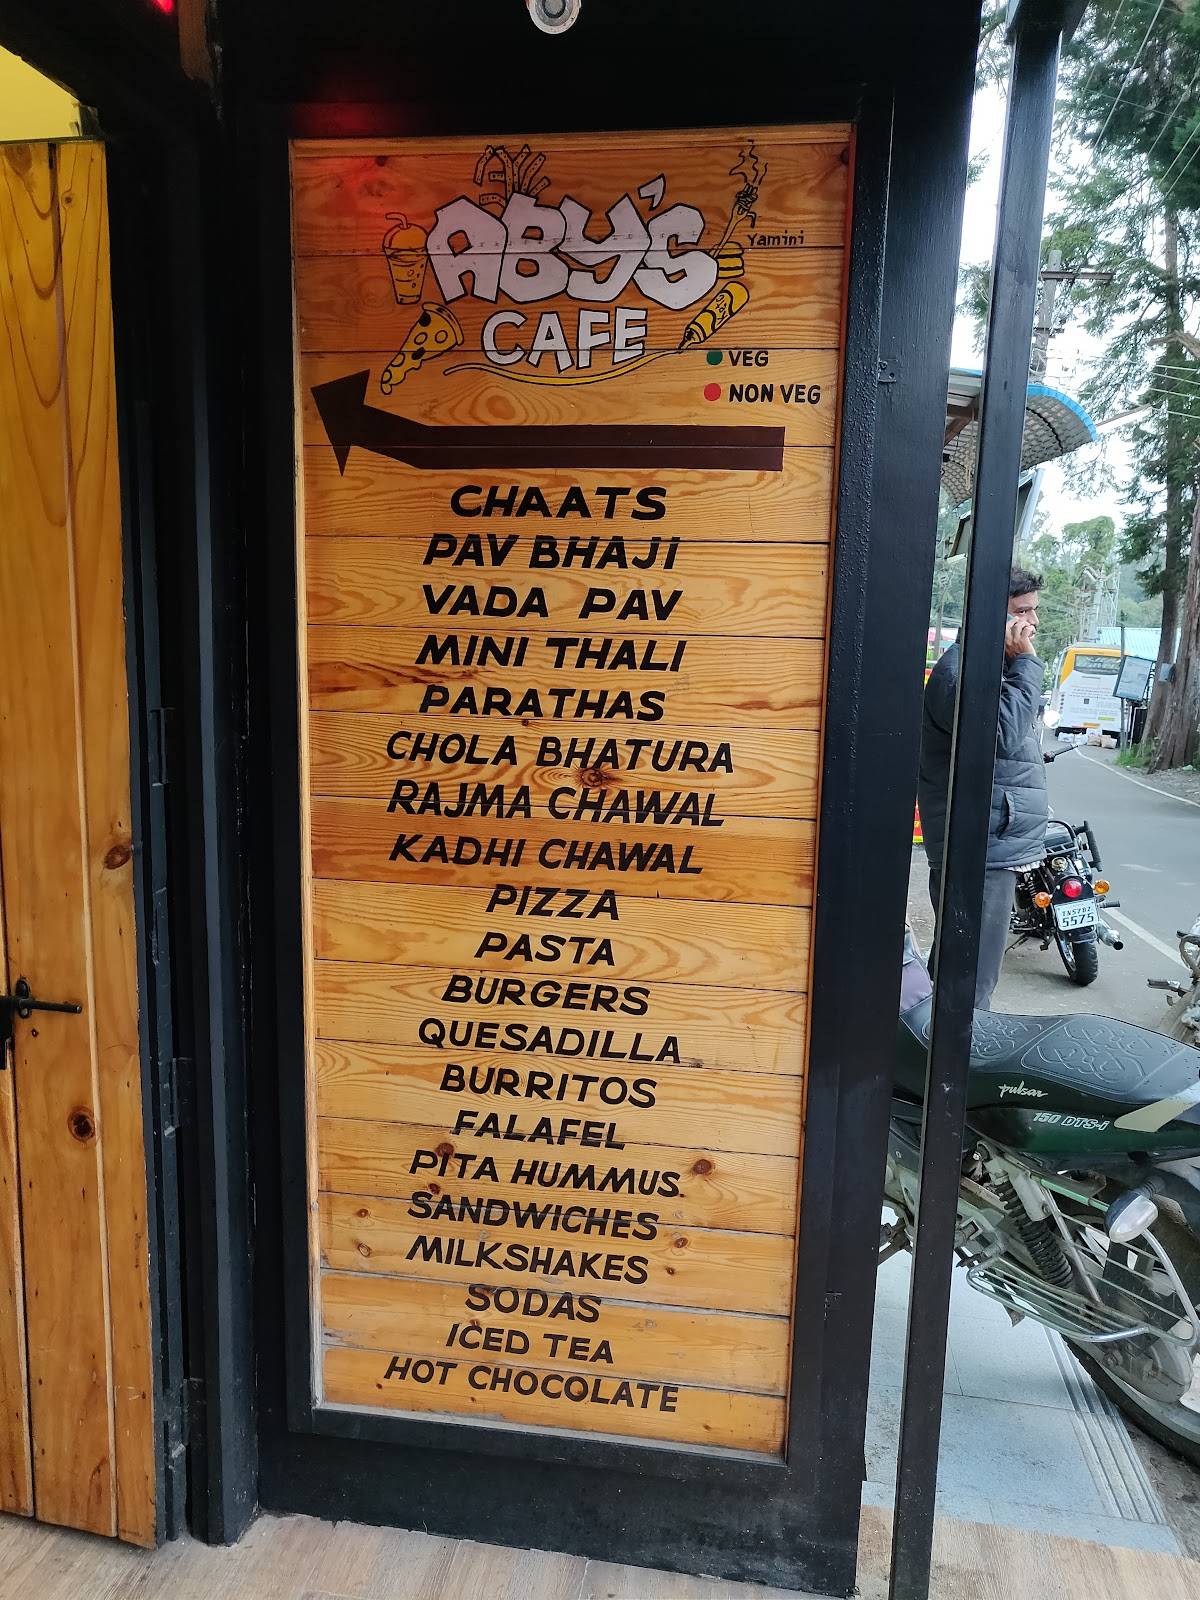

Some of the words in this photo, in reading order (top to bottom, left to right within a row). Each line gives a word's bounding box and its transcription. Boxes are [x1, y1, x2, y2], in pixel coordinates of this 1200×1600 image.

[427, 174, 719, 310] ABY'S
[747, 229, 804, 246] Yamini
[481, 307, 648, 372] CAFE
[728, 350, 769, 367] VEG
[729, 383, 774, 403] NON
[780, 384, 821, 404] VEG
[451, 485, 667, 520] CHAATS
[423, 533, 519, 566] PAV
[529, 535, 680, 569] BHAJI
[422, 584, 549, 617] VADA
[578, 588, 683, 621] PAV
[415, 634, 529, 666] MINI
[546, 637, 687, 672] THALI
[419, 684, 665, 721] PARATHAS
[387, 731, 518, 766] CHOLA
[536, 737, 734, 773] BHATURA
[386, 779, 531, 819] RAJMA
[548, 787, 725, 826] CHAWAL
[388, 833, 526, 867] KADHI
[538, 838, 703, 874] CHAWAL
[485, 884, 619, 920] PIZZA
[1062, 911, 1094, 928] 5575
[474, 932, 615, 966] PASTA
[441, 975, 650, 1016] BURGERS
[418, 1018, 681, 1064] QUESADILLA
[440, 1064, 657, 1108] BURRITOS
[998, 1080, 1049, 1099] pulsar
[451, 1110, 626, 1150] FALAFEL
[1033, 1112, 1062, 1124] 150
[409, 1150, 499, 1182] PITA
[407, 1191, 659, 1241] SANDWICHES
[405, 1235, 649, 1285] MILKSHAKES
[465, 1283, 601, 1323] SODAS
[446, 1324, 529, 1354] ICED
[543, 1333, 613, 1364] TEA
[384, 1356, 457, 1385] HOT
[468, 1365, 679, 1413] CHOCOLATE
